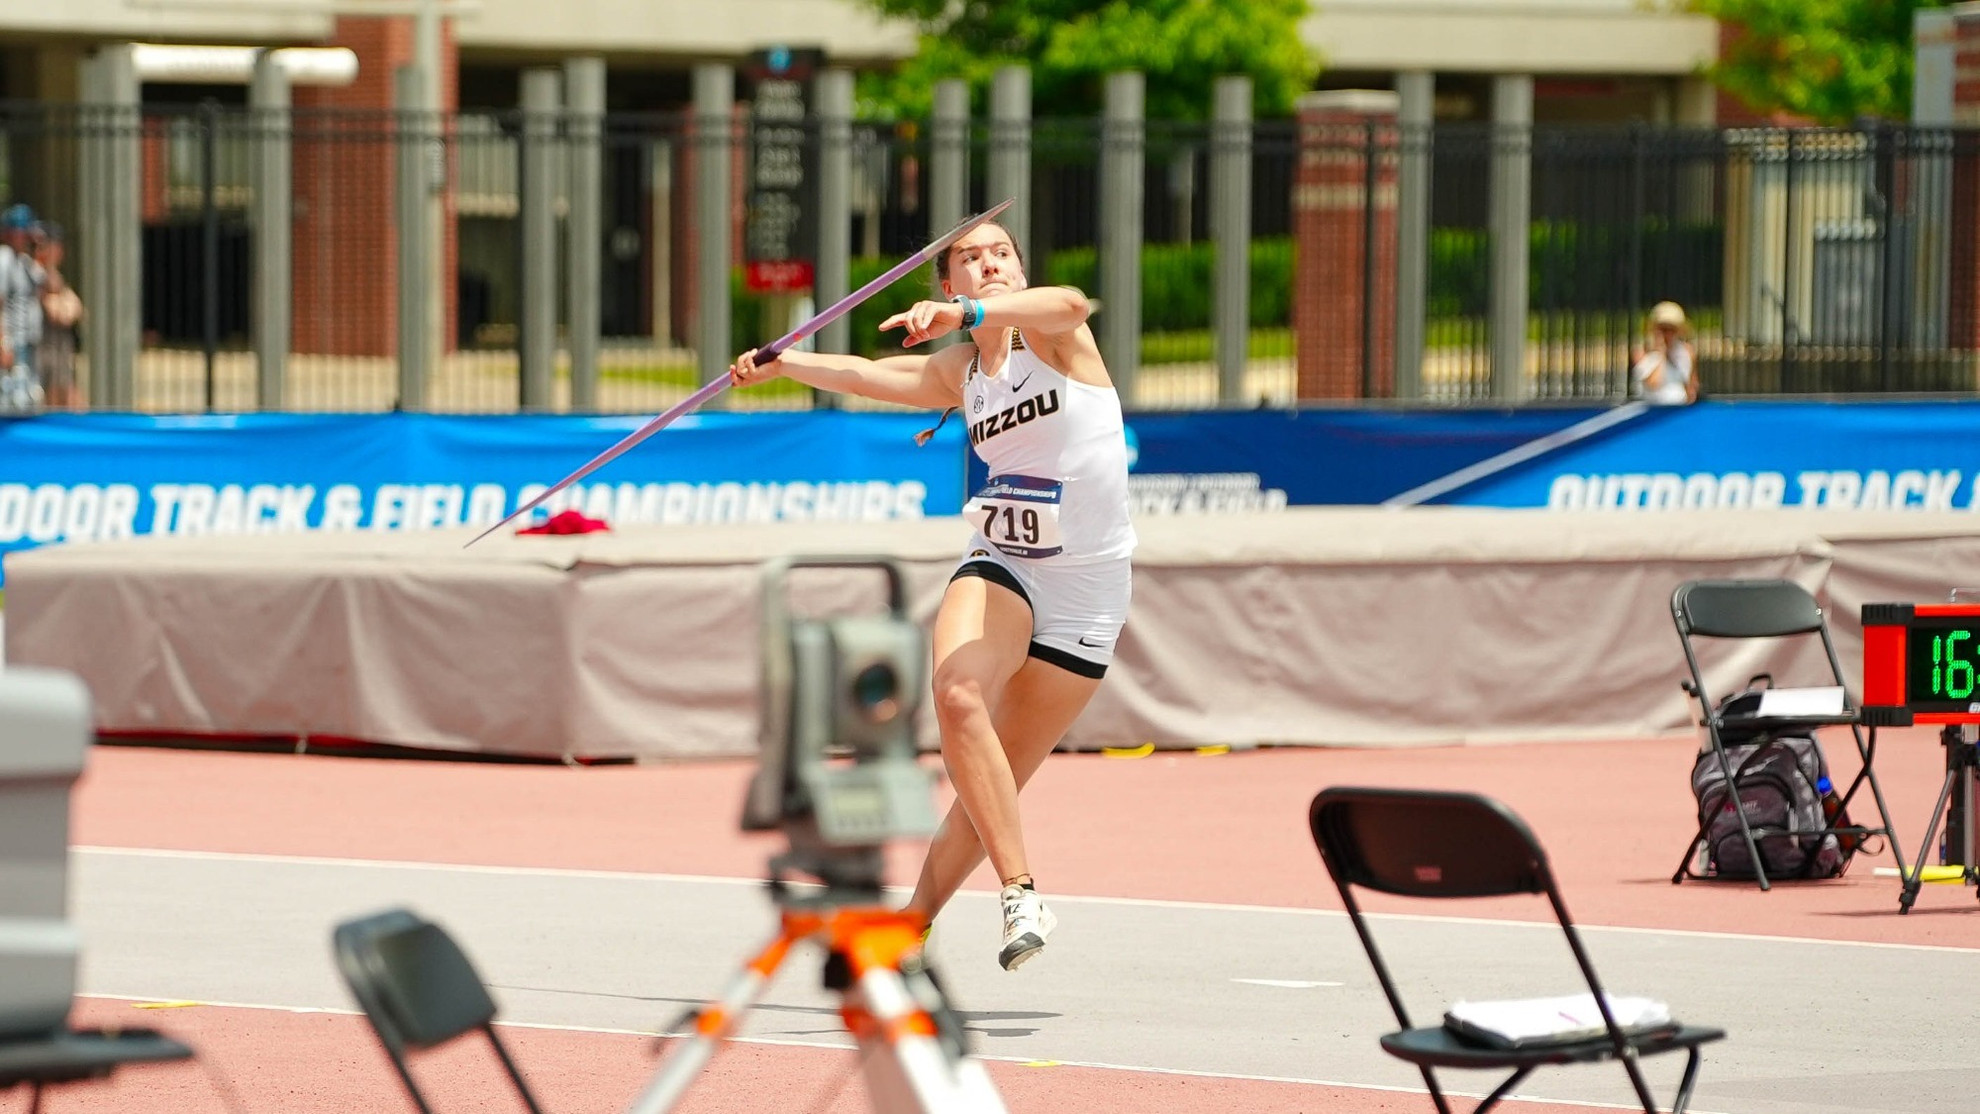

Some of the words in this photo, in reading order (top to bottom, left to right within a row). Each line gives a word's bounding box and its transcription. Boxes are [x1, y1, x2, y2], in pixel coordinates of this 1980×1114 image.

[969, 388, 1060, 446] MIZZOU
[151, 482, 316, 537] TRACK
[322, 483, 363, 531] &
[371, 483, 507, 531] FIELD
[515, 480, 927, 527] CHAMPIONSHIPS
[1549, 473, 1787, 512] OUTDOOR
[1797, 469, 1962, 512] TRACK
[981, 504, 1040, 545] 719
